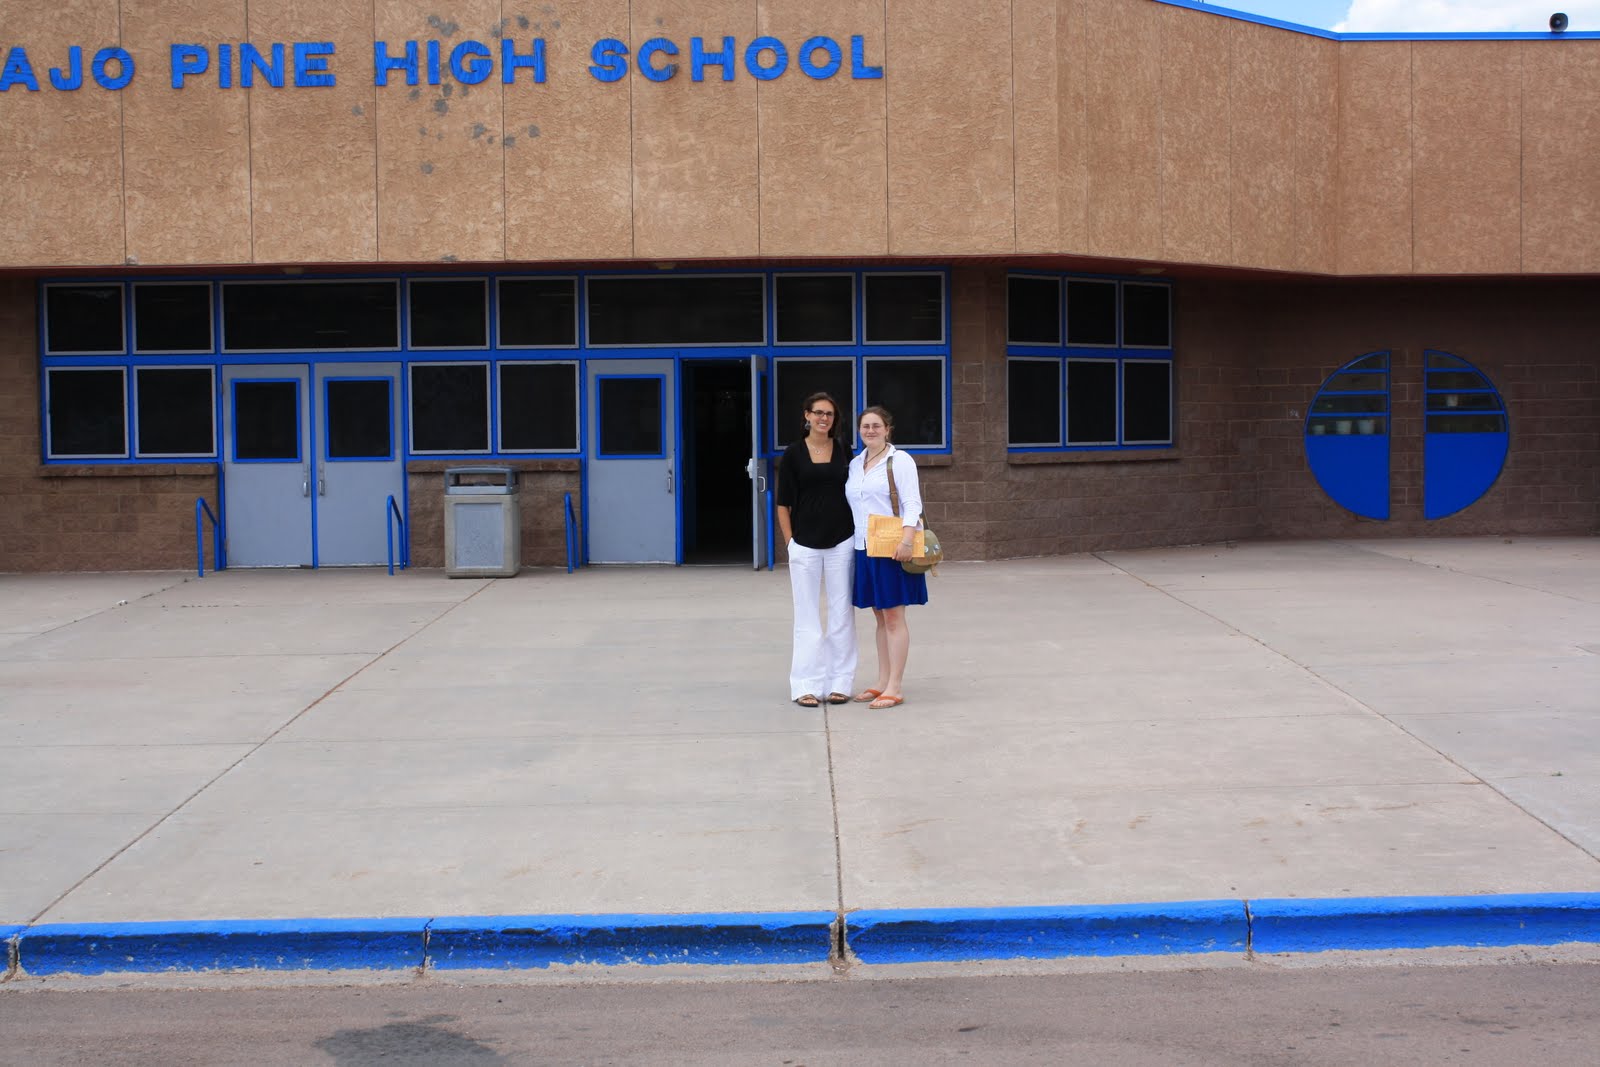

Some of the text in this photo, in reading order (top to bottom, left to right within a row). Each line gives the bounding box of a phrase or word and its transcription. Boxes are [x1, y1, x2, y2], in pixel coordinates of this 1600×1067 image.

[0, 36, 883, 91] AJO PINE HIGH SCHOOL
